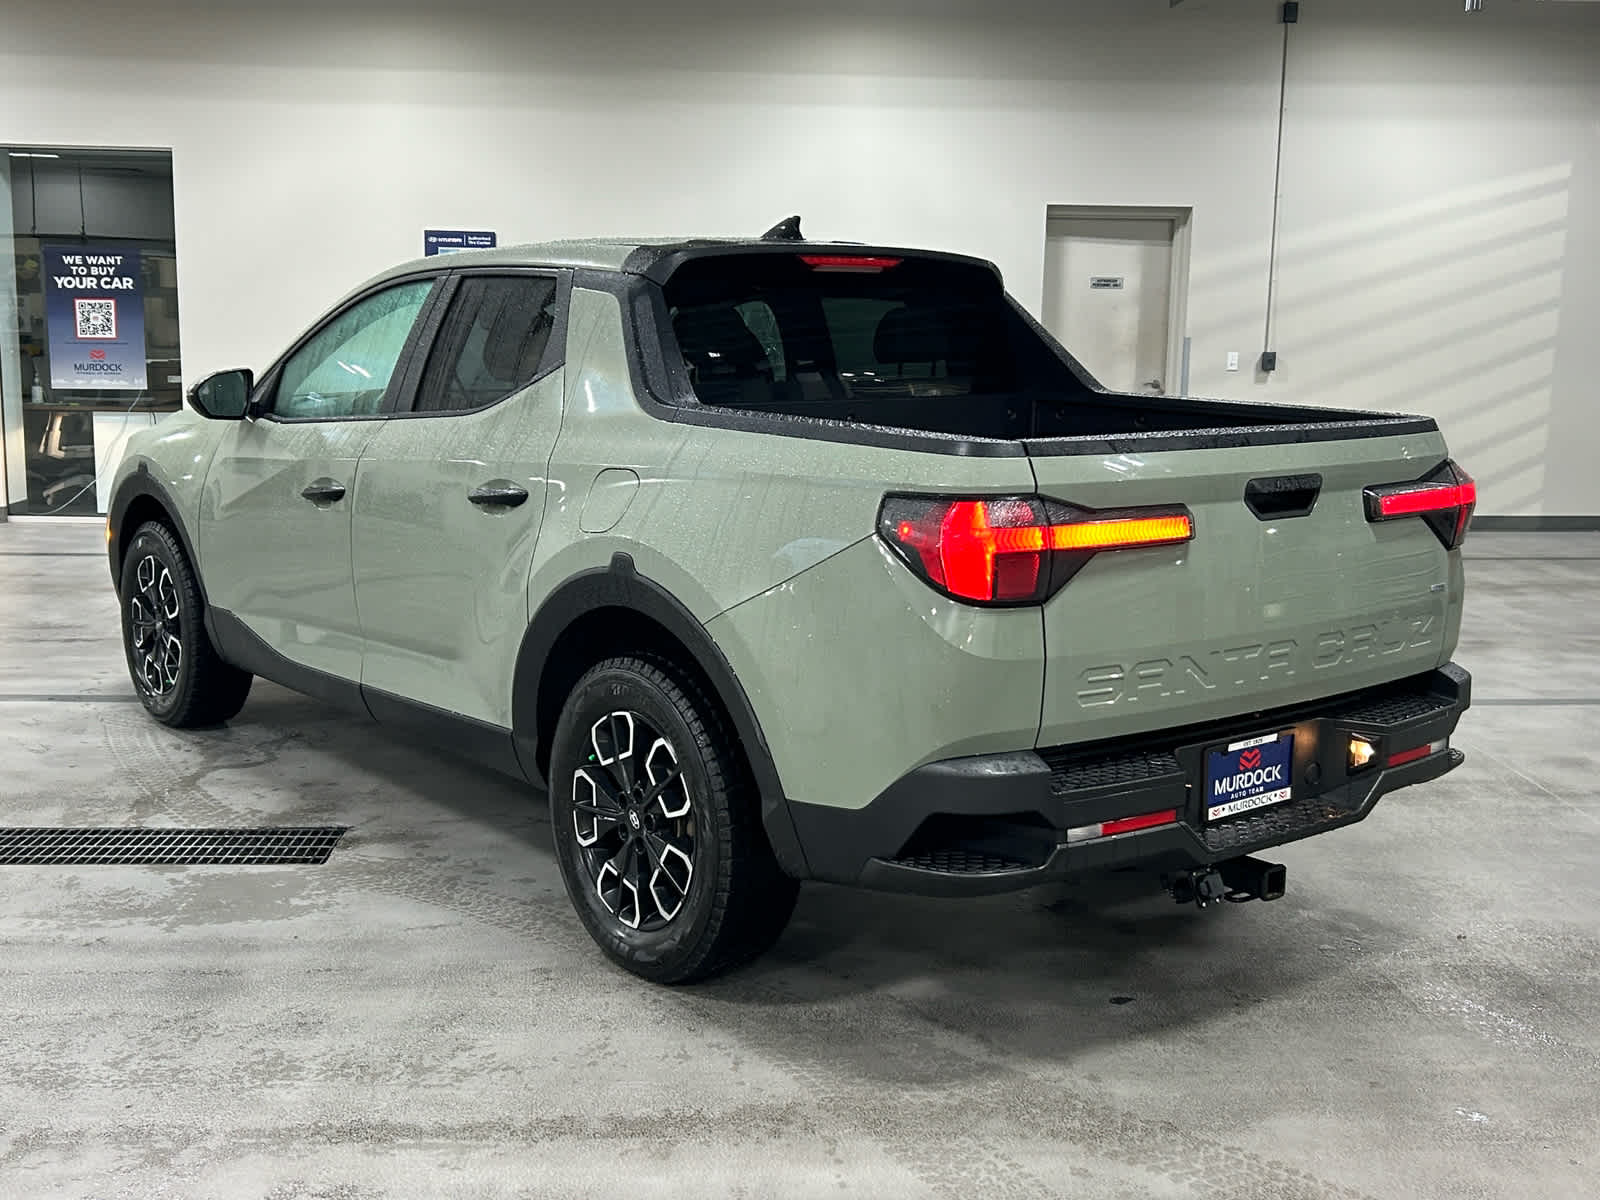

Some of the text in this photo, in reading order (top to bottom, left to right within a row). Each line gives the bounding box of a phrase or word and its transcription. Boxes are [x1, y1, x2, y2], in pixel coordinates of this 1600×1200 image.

[62, 255, 122, 265] WE WANT
[70, 266, 115, 276] TO BUY
[53, 276, 134, 290] YOUR CAR
[74, 363, 122, 372] MURDOCK
[1076, 639, 1298, 708] SANTA
[1214, 764, 1281, 796] MURDOCK
[1230, 786, 1264, 799] AUTO TEAM
[1228, 793, 1273, 813] MURDOCK
